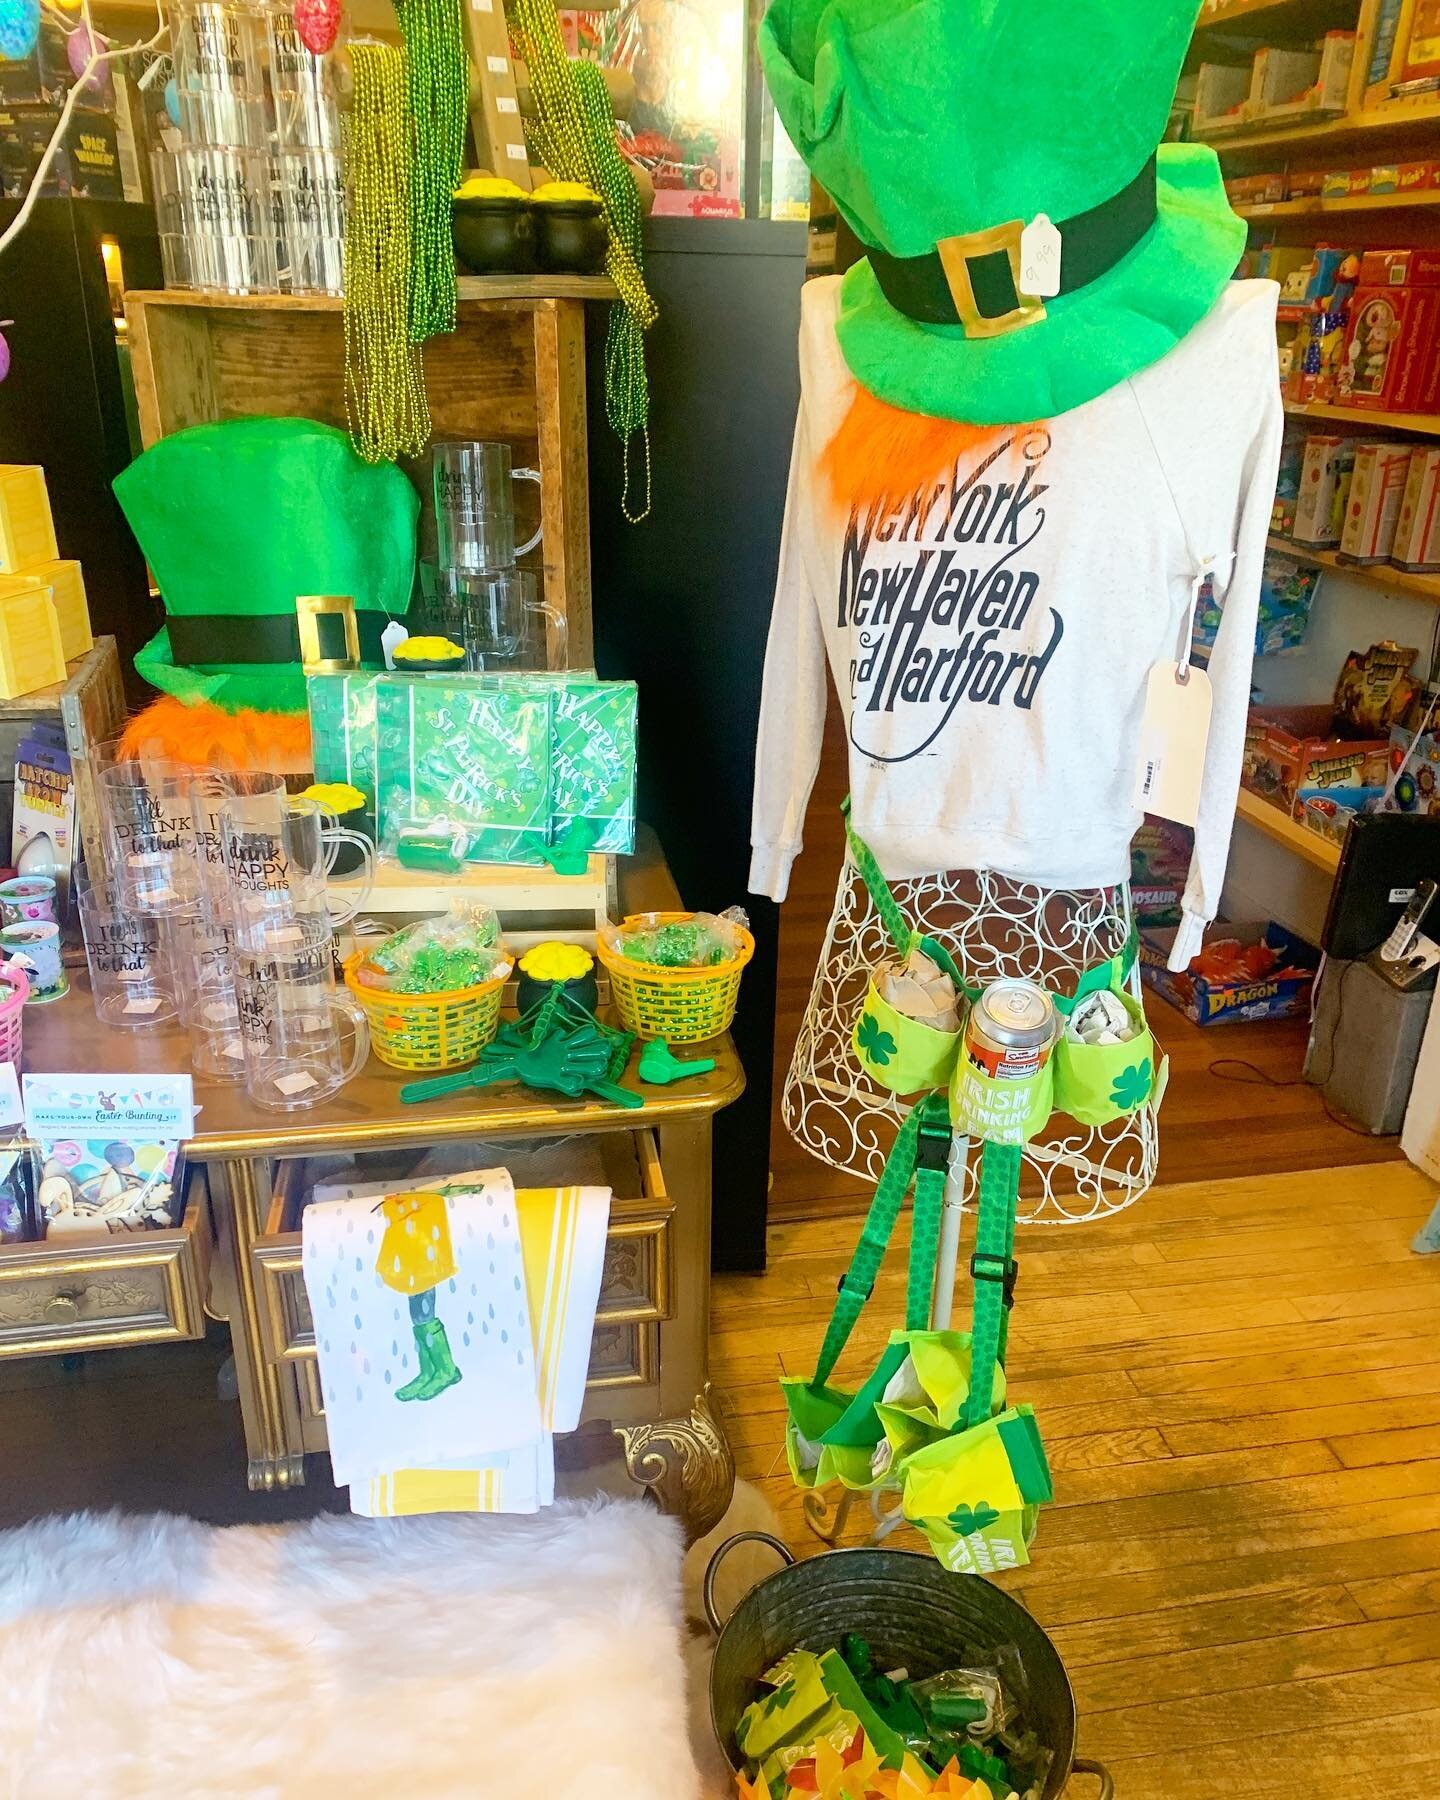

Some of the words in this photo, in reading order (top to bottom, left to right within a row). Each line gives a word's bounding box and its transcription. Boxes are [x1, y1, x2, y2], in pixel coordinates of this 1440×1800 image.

[935, 428, 1052, 545] York
[838, 545, 914, 628] New
[896, 515, 1045, 637] Haven
[863, 607, 1065, 735] Hartford
[114, 816, 192, 839] DRINK
[228, 862, 289, 880] HAPPY
[231, 876, 290, 891] THOUGHTS
[86, 941, 157, 955] DRINK
[110, 956, 147, 973] that
[1208, 982, 1278, 1016] DRAGON
[962, 1072, 1032, 1111] IRISH
[95, 1109, 123, 1123] Easter
[125, 1109, 169, 1123] Bunting
[955, 1086, 1032, 1127] DRINKING
